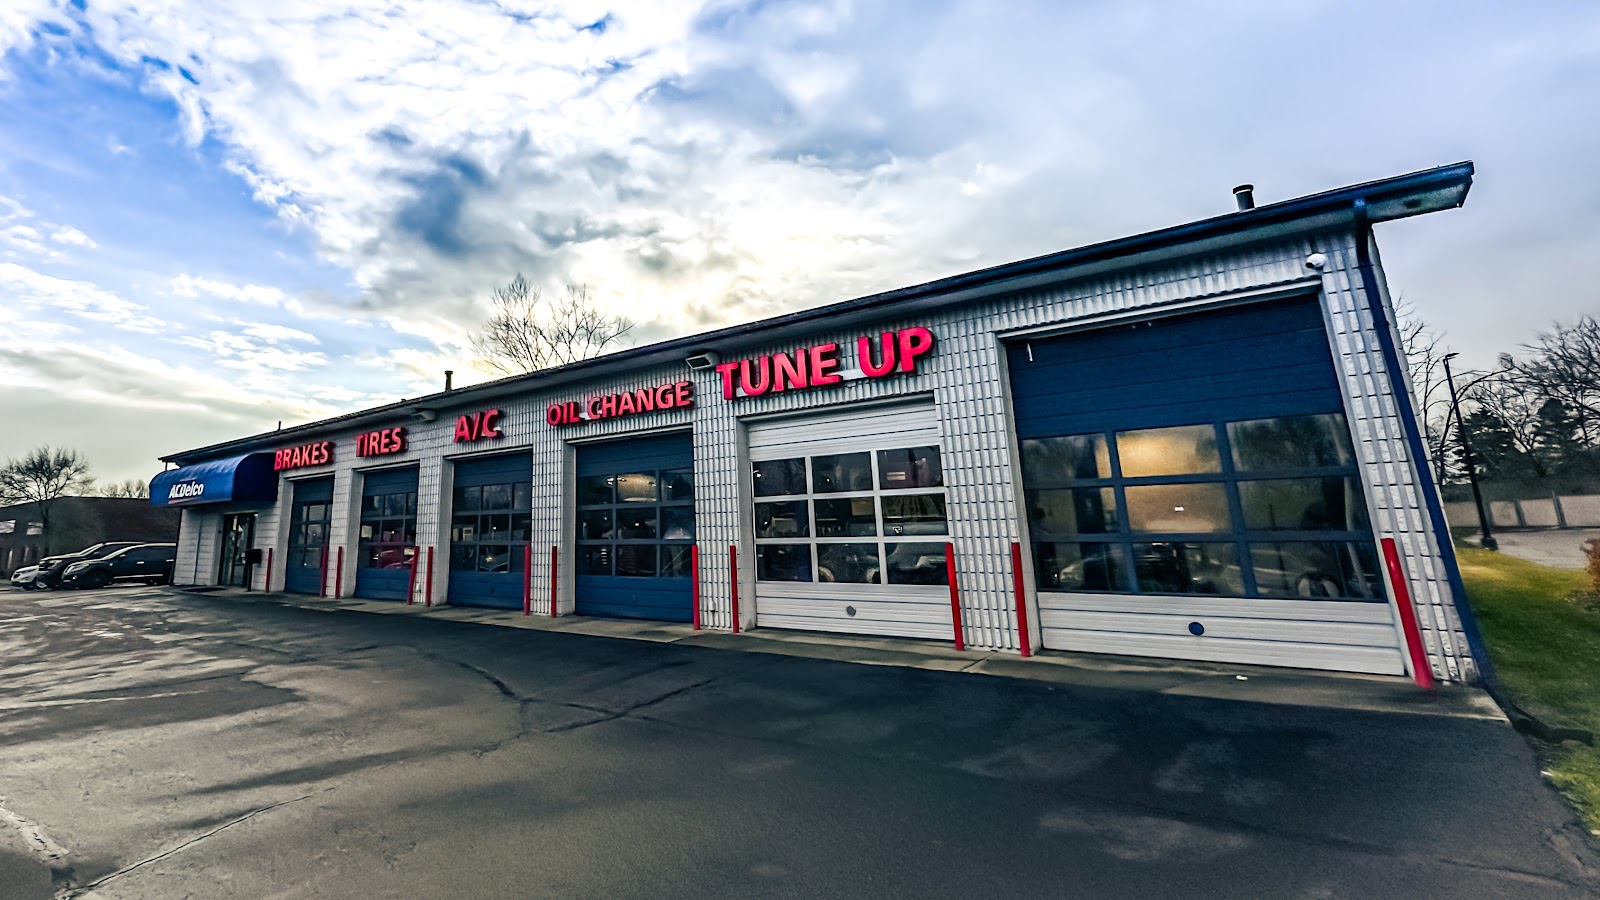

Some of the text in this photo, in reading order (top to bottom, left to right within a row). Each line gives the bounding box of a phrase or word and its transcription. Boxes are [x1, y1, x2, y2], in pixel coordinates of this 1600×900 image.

[715, 326, 933, 400] TUNE UP
[546, 380, 694, 427] OIL CHANGE
[454, 408, 503, 443] A/C
[273, 441, 332, 471] BRAKES
[355, 427, 405, 458] TIRES
[168, 481, 205, 499] ACDelco
